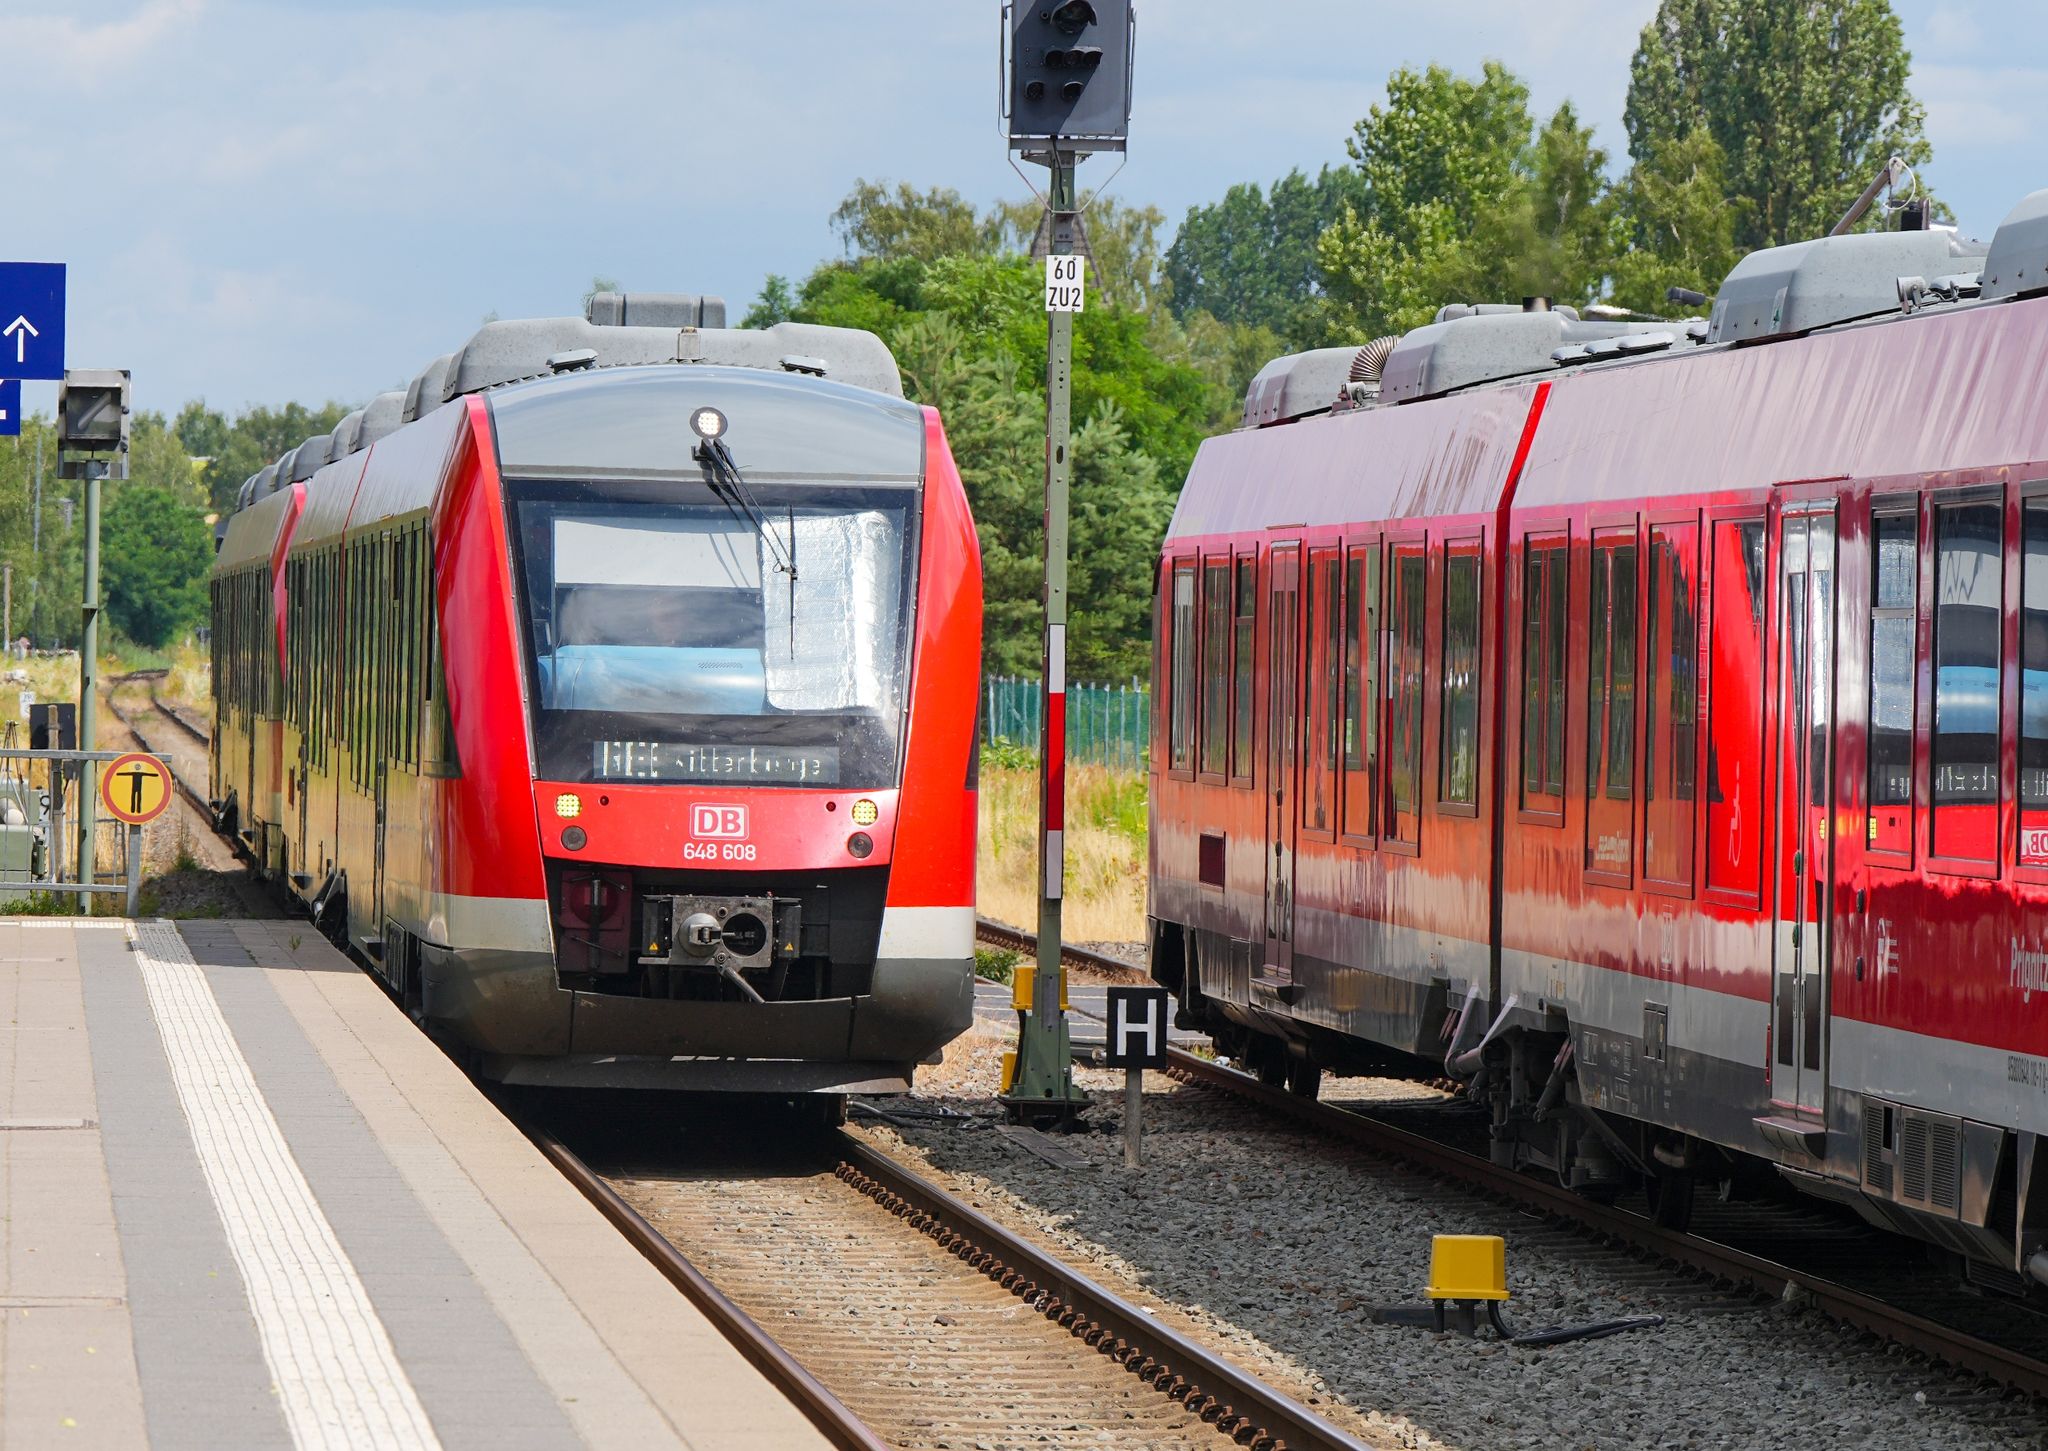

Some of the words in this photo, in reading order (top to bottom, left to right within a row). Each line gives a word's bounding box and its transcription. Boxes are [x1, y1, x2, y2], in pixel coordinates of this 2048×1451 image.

[1054, 260, 1076, 280] 60
[1048, 286, 1081, 307] ZU2
[696, 808, 743, 835] DB
[683, 842, 718, 861] 648
[722, 843, 757, 862] 608
[1116, 998, 1158, 1056] H
